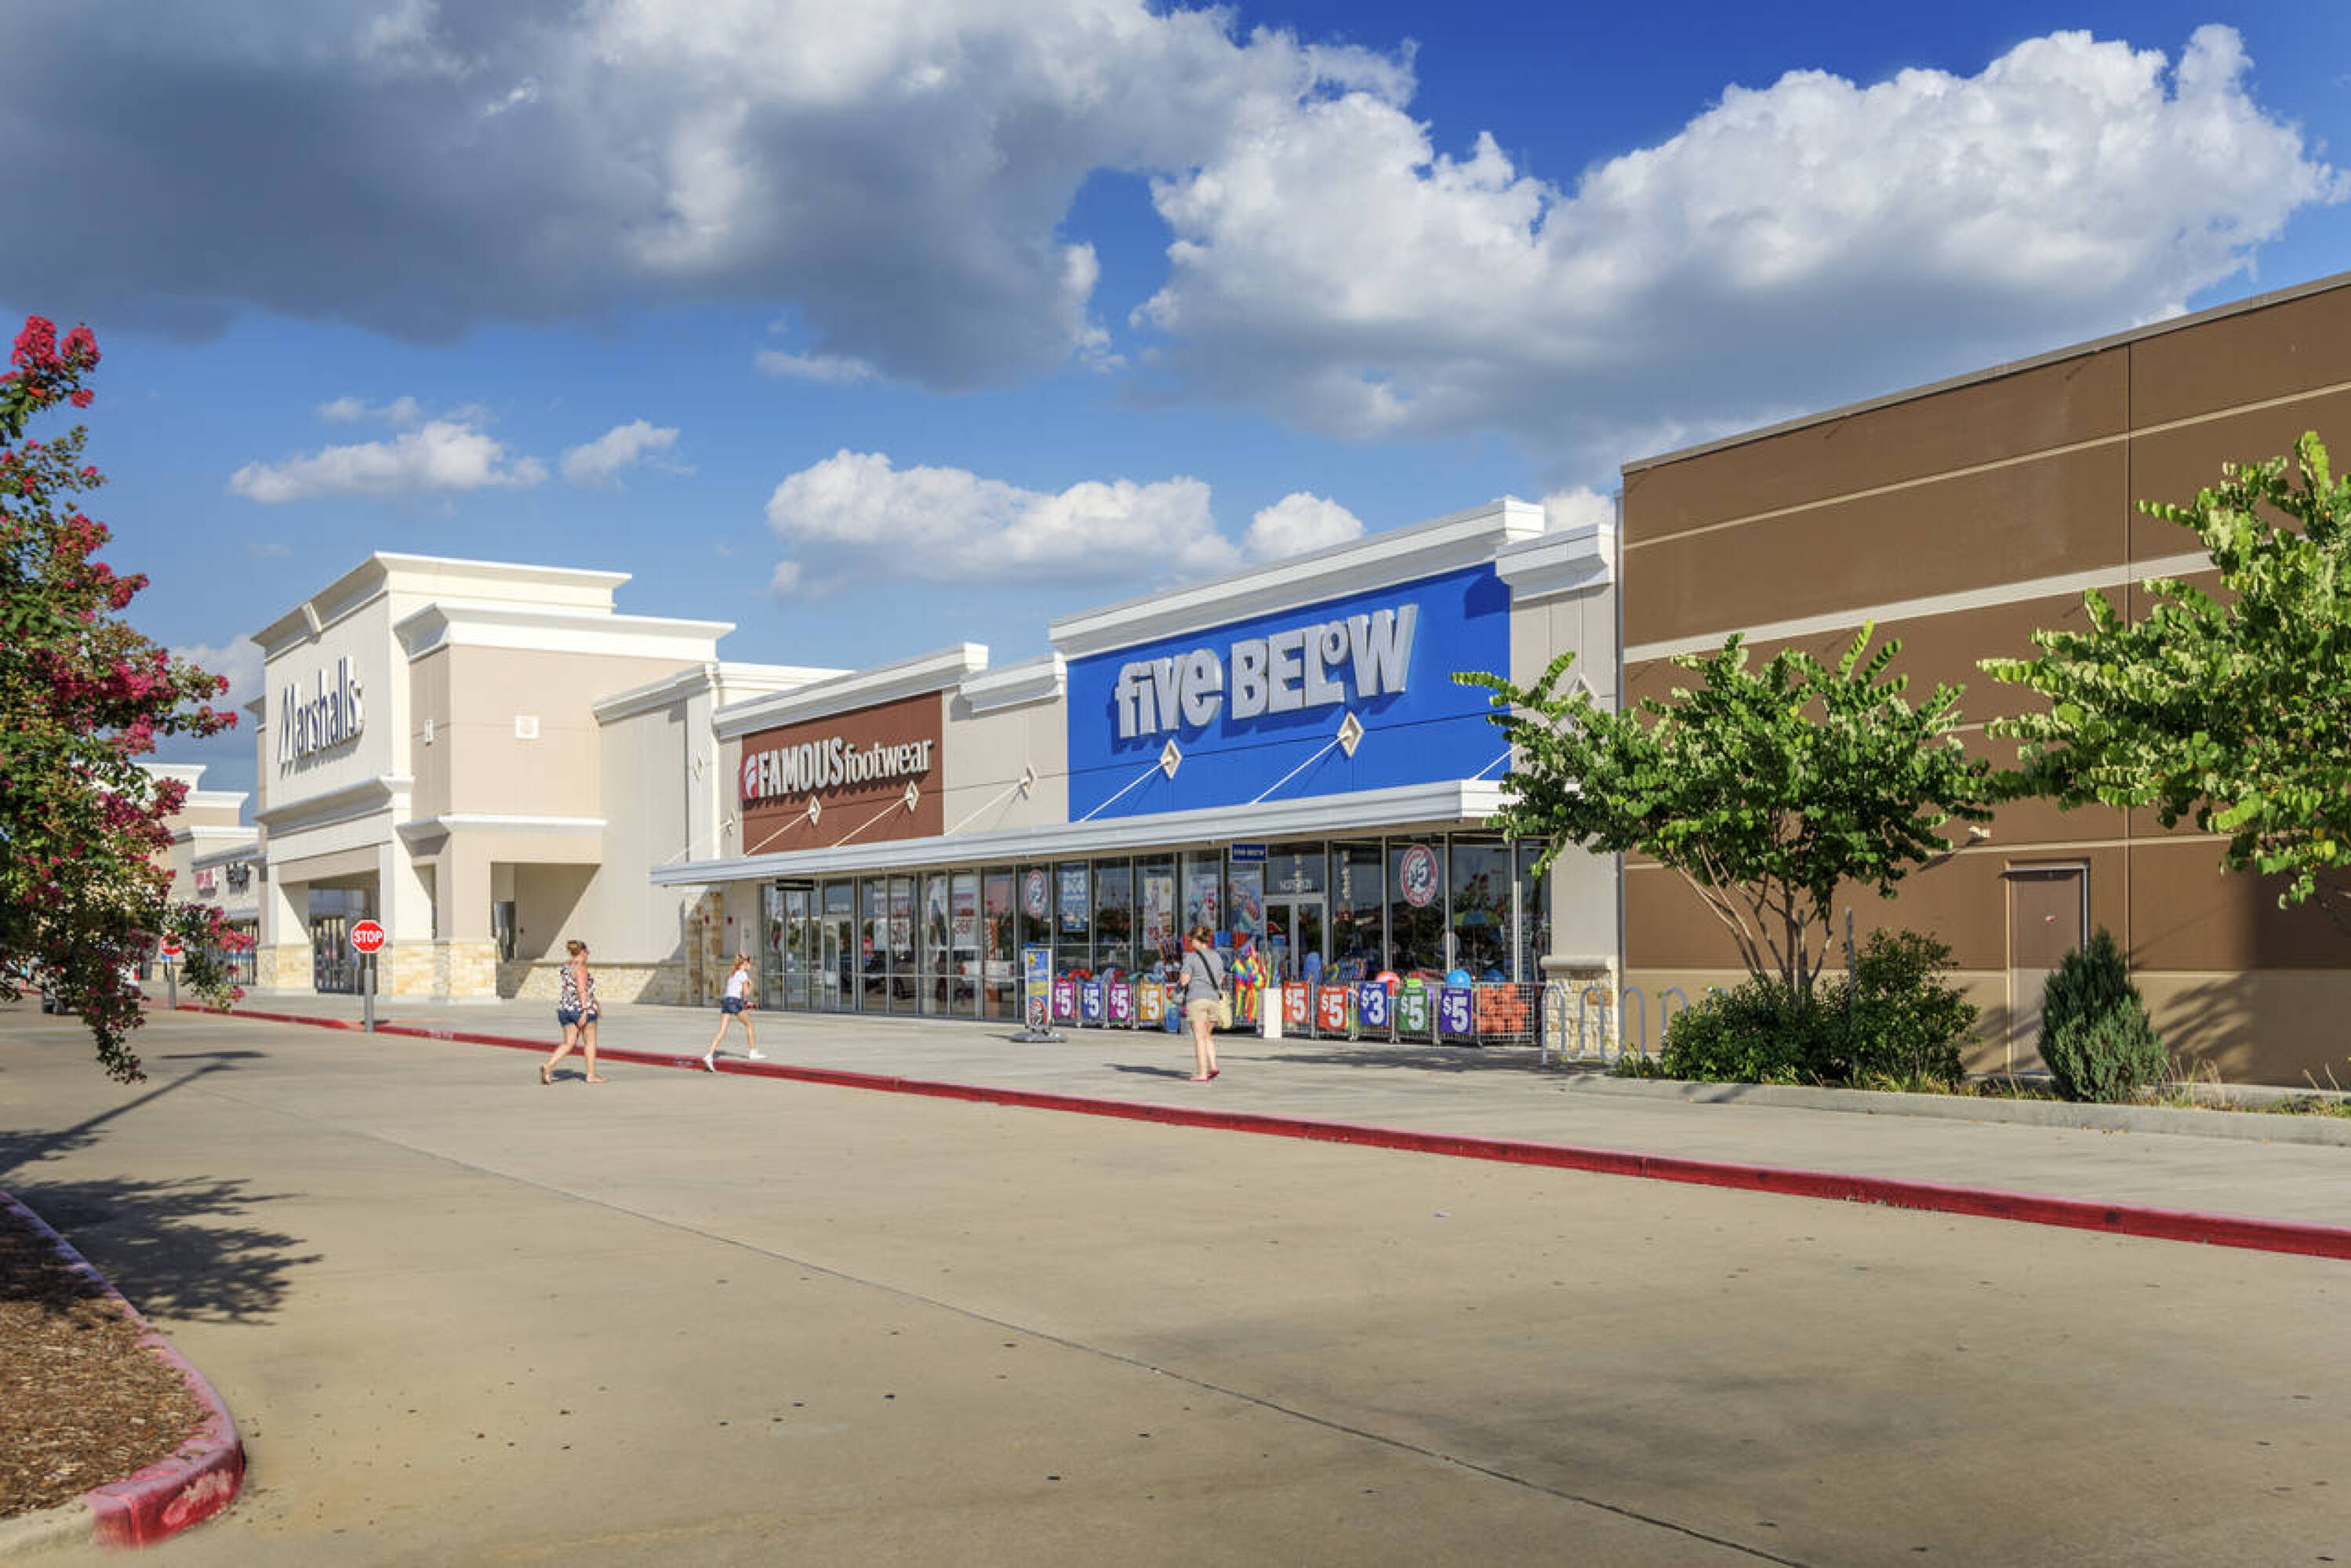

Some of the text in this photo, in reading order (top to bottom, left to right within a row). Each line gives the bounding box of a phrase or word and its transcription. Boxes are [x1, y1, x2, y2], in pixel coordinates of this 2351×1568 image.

[1115, 604, 1419, 739] five BELOW
[278, 655, 364, 764] Marshalls
[758, 737, 932, 797] FAMOUS footwear
[354, 930, 383, 942] STOP
[1056, 989, 1071, 1016] $5
[1083, 989, 1099, 1016] $5
[1111, 989, 1128, 1018] $5
[1143, 990, 1160, 1019] $5
[1286, 988, 1306, 1020] $5
[1321, 993, 1343, 1027] $5
[1361, 989, 1384, 1025] $3
[1401, 995, 1424, 1030] $5
[1443, 995, 1469, 1032] $5
